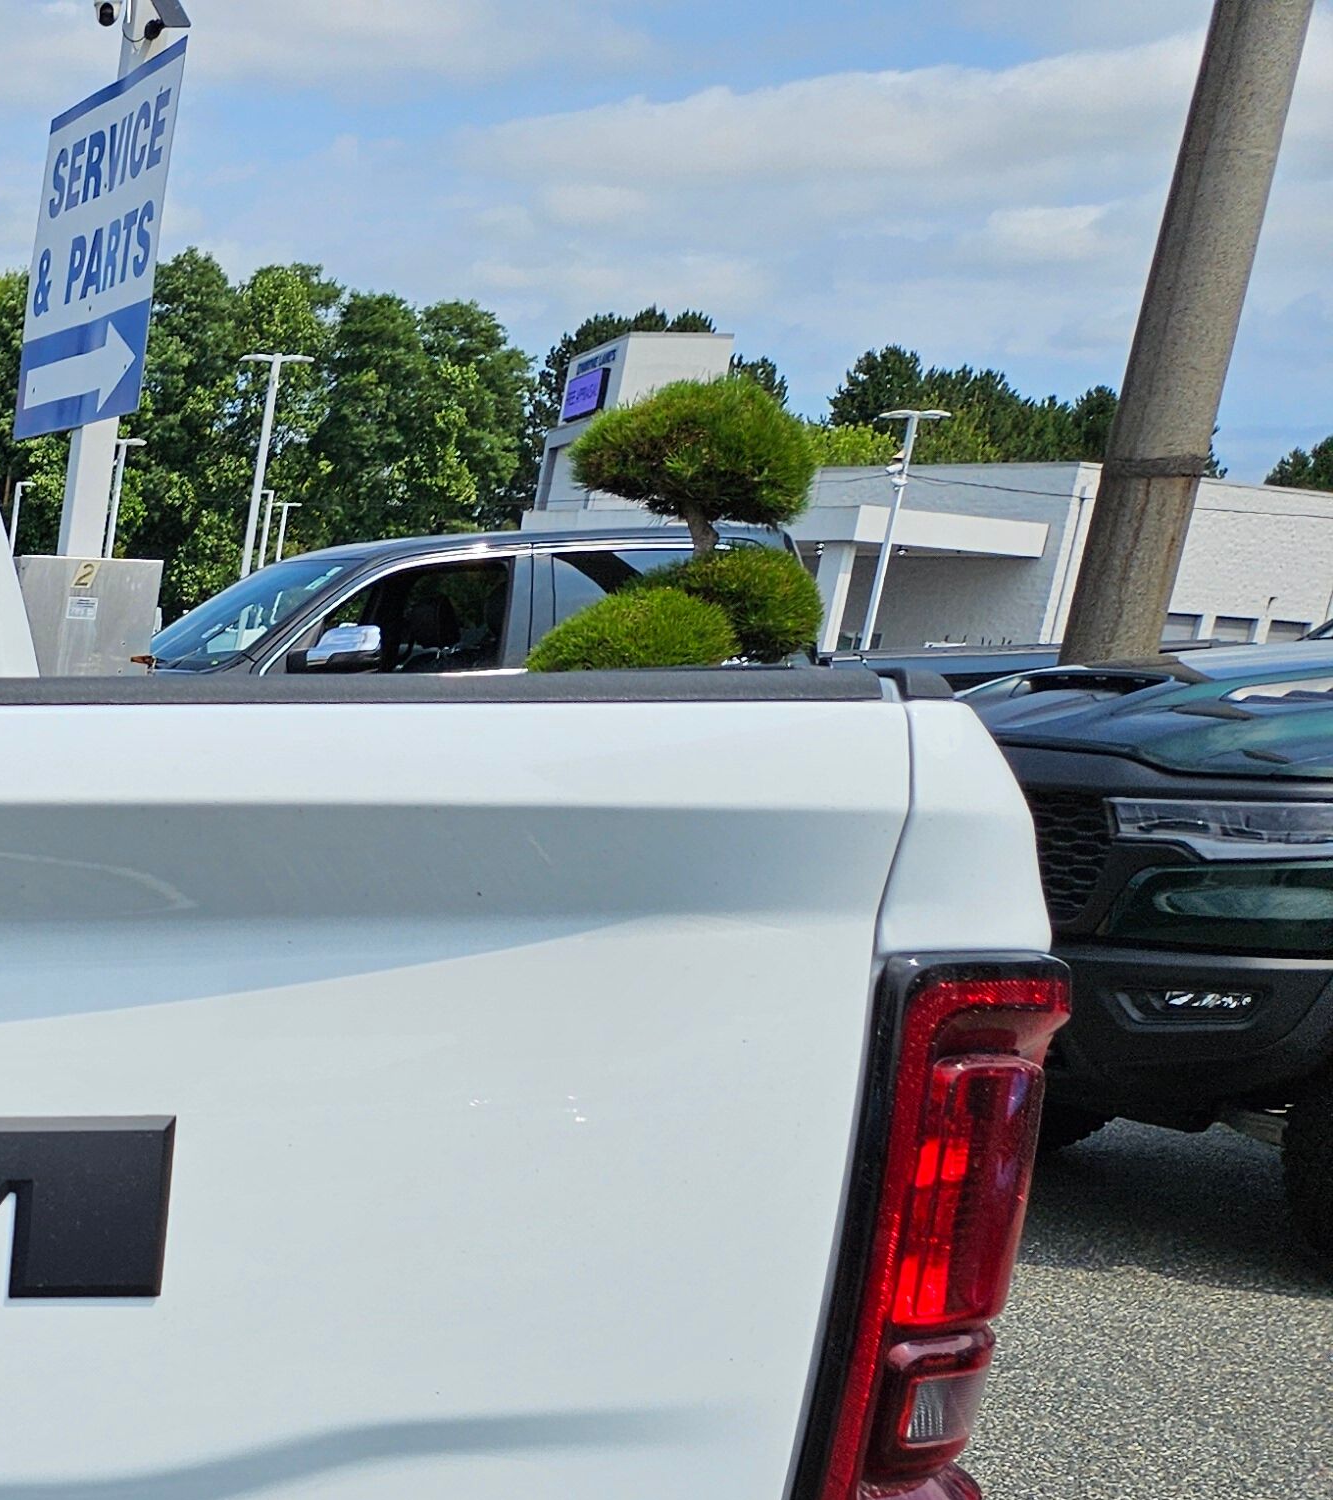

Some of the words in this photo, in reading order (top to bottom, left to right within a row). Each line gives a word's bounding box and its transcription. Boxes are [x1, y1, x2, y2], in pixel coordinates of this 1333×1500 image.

[49, 88, 171, 218] SERVICE
[33, 247, 52, 317] &
[64, 200, 154, 305] PARTS
[74, 563, 94, 586] 2
